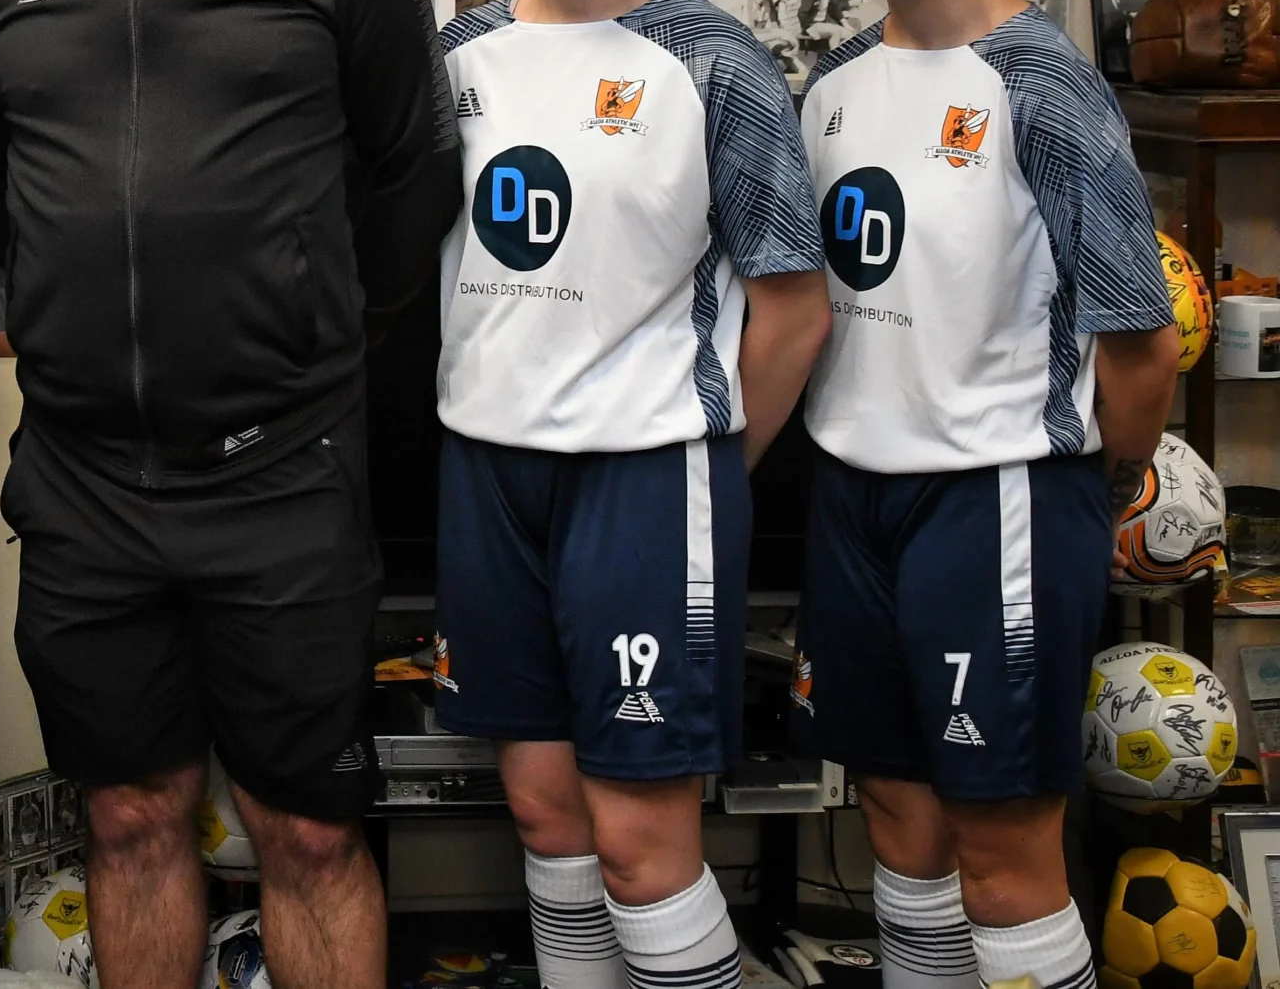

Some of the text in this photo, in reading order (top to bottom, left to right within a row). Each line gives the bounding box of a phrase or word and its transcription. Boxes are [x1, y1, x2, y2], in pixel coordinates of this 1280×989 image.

[467, 87, 483, 117] PENDLE
[460, 282, 583, 302] DAVIS DISTRIBUTION
[612, 633, 659, 687] 19
[1099, 650, 1143, 665] ALLOA
[944, 652, 972, 706] 7
[636, 691, 665, 723] PENDLE
[958, 713, 986, 746] PENDLE
